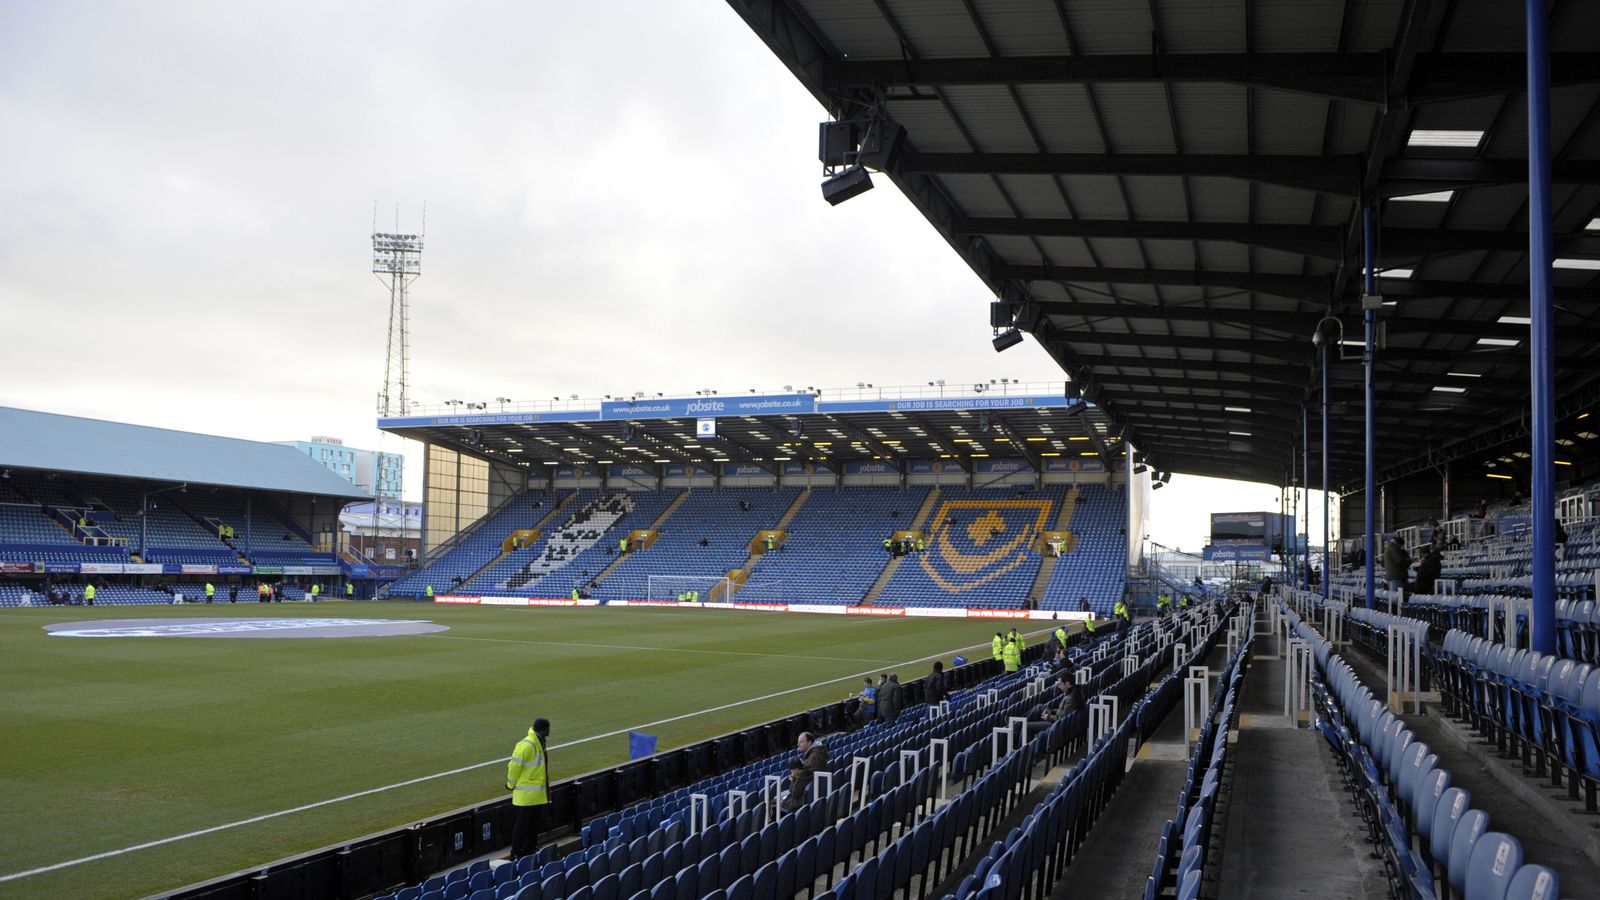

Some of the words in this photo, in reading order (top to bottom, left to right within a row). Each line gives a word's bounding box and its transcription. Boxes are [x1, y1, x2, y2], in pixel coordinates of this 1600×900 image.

[613, 404, 671, 414] www.jobsite.co.uk
[686, 399, 725, 415] jobsite
[739, 399, 802, 409] www.jobsite.co.uk
[896, 401, 911, 409] OUR
[926, 400, 933, 408] IS
[934, 400, 974, 408] SEARCHING
[975, 399, 990, 407] FOR
[990, 399, 1010, 407] YOUR
[1010, 398, 1024, 406] JOB
[736, 465, 761, 476] jobsite
[858, 463, 886, 474] jobsite
[991, 461, 1019, 472] jobsite
[1211, 550, 1236, 560] jobsite
